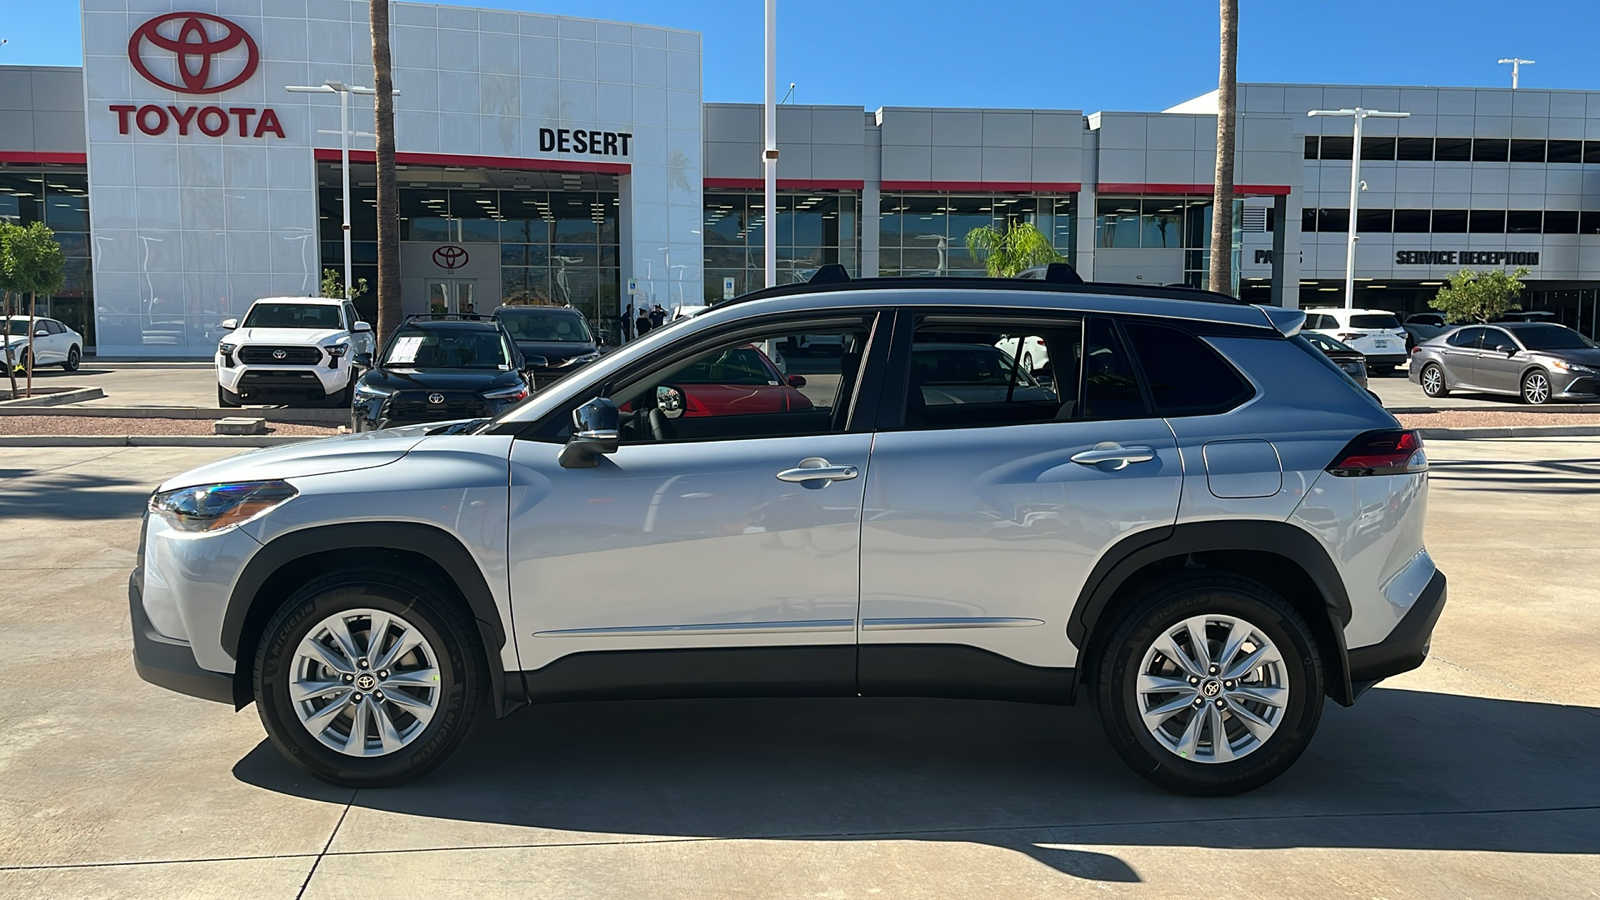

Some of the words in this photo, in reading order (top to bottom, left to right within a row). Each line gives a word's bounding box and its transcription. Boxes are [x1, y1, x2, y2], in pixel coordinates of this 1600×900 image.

[110, 105, 285, 138] TOYOTA
[539, 128, 633, 157] DESERT
[1396, 250, 1458, 265] SERVICE
[1458, 251, 1540, 266] RECEPTION
[271, 603, 314, 657] MICHELIN
[412, 711, 455, 763] MICHELIN
